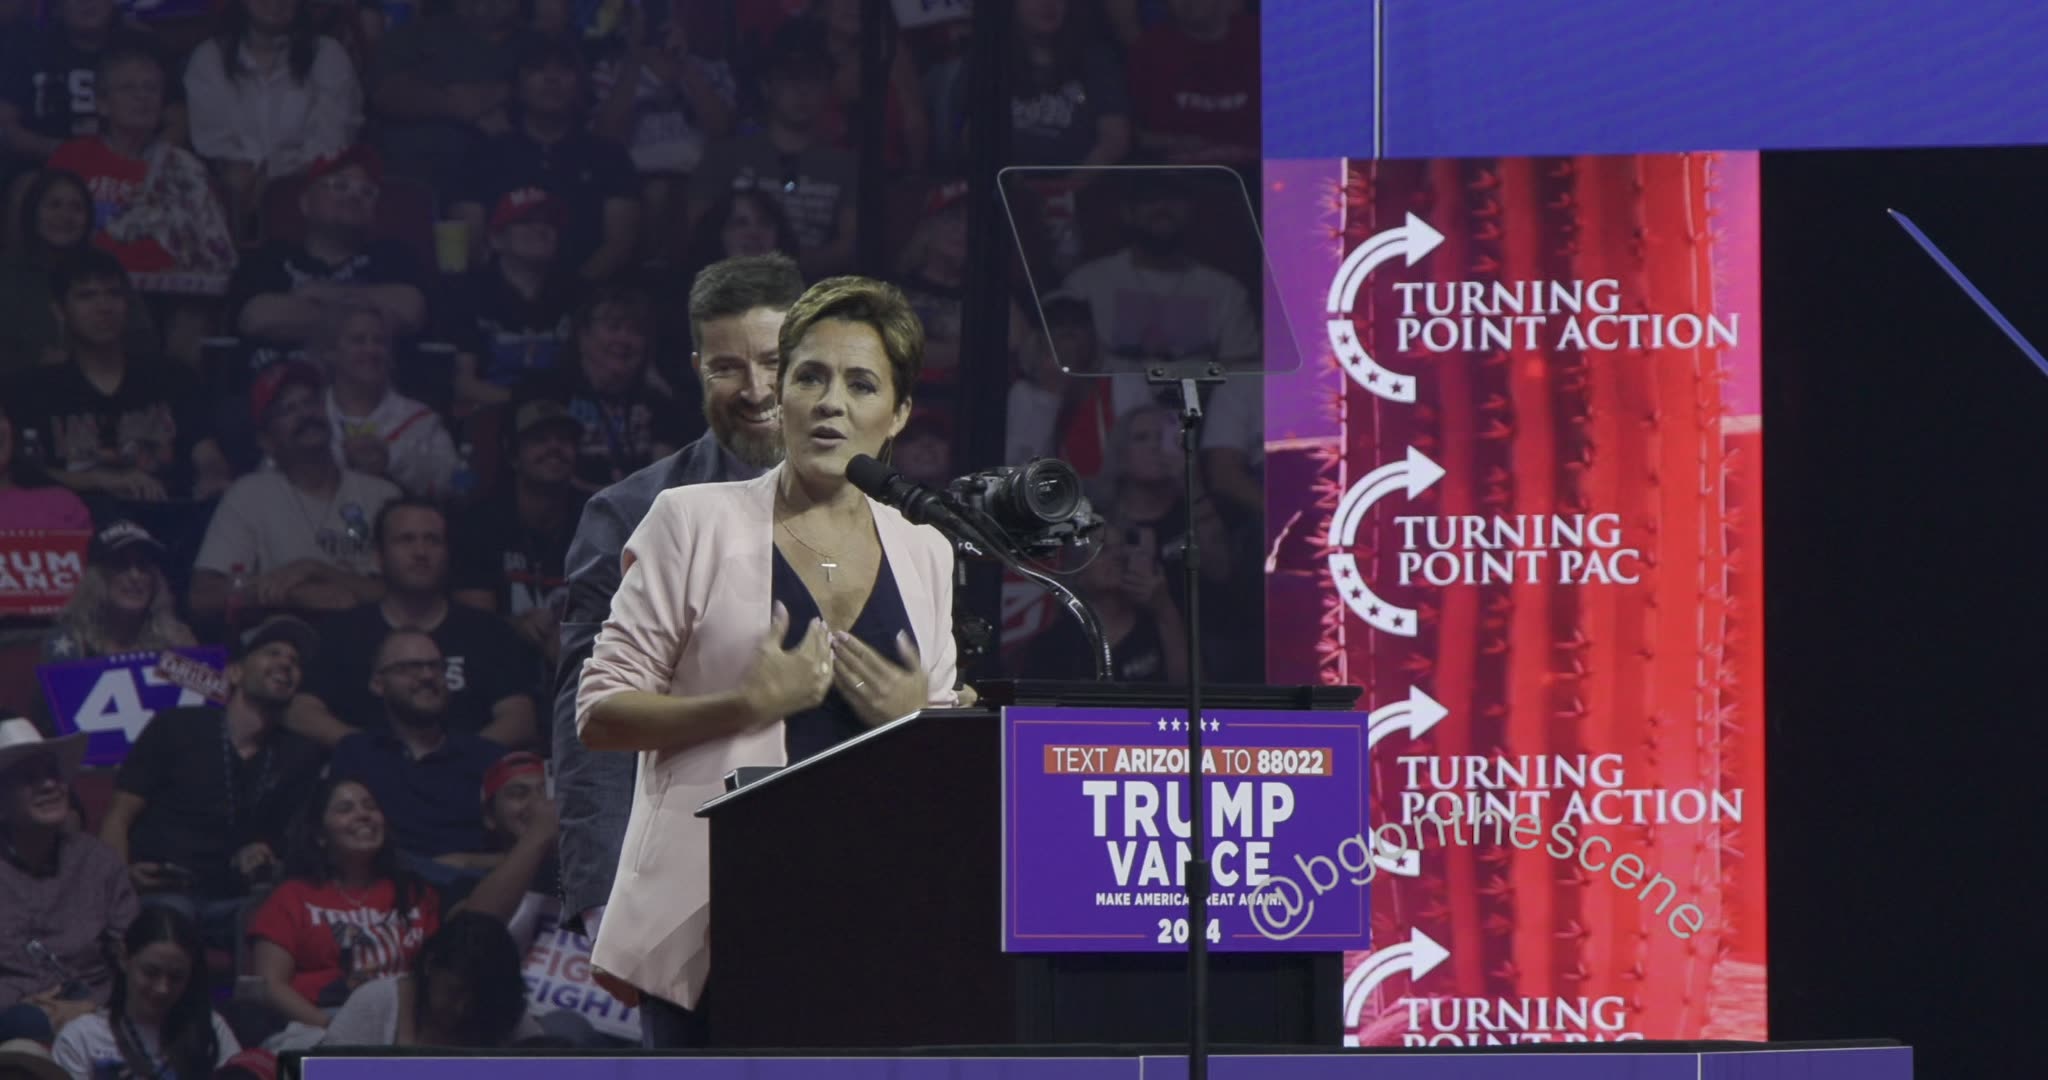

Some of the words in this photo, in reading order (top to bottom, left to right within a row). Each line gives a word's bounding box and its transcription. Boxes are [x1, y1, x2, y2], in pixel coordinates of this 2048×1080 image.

[1393, 279, 1620, 315] TURNING
[1397, 315, 1546, 351] POINT
[1557, 313, 1740, 350] ACTION
[1394, 513, 1622, 550] TURNING
[1398, 550, 1547, 586] POINT
[1559, 549, 1640, 585] PAC
[1052, 747, 1108, 772] TEXT
[1114, 748, 1217, 773] ARIZOA
[1222, 749, 1251, 773] TO
[1257, 749, 1324, 774] 88022
[1397, 754, 1624, 790] TURNING
[1082, 781, 1295, 838] TRUMP
[1401, 789, 1550, 825] POINT
[1562, 788, 1744, 825] ACTION
[1096, 893, 1130, 905] MAKE
[1134, 893, 1189, 905] AMERICA
[1206, 893, 1235, 906] EAT
[1157, 918, 1221, 943] 204
[522, 946, 592, 984] FIG
[1398, 997, 1625, 1032] TURNING
